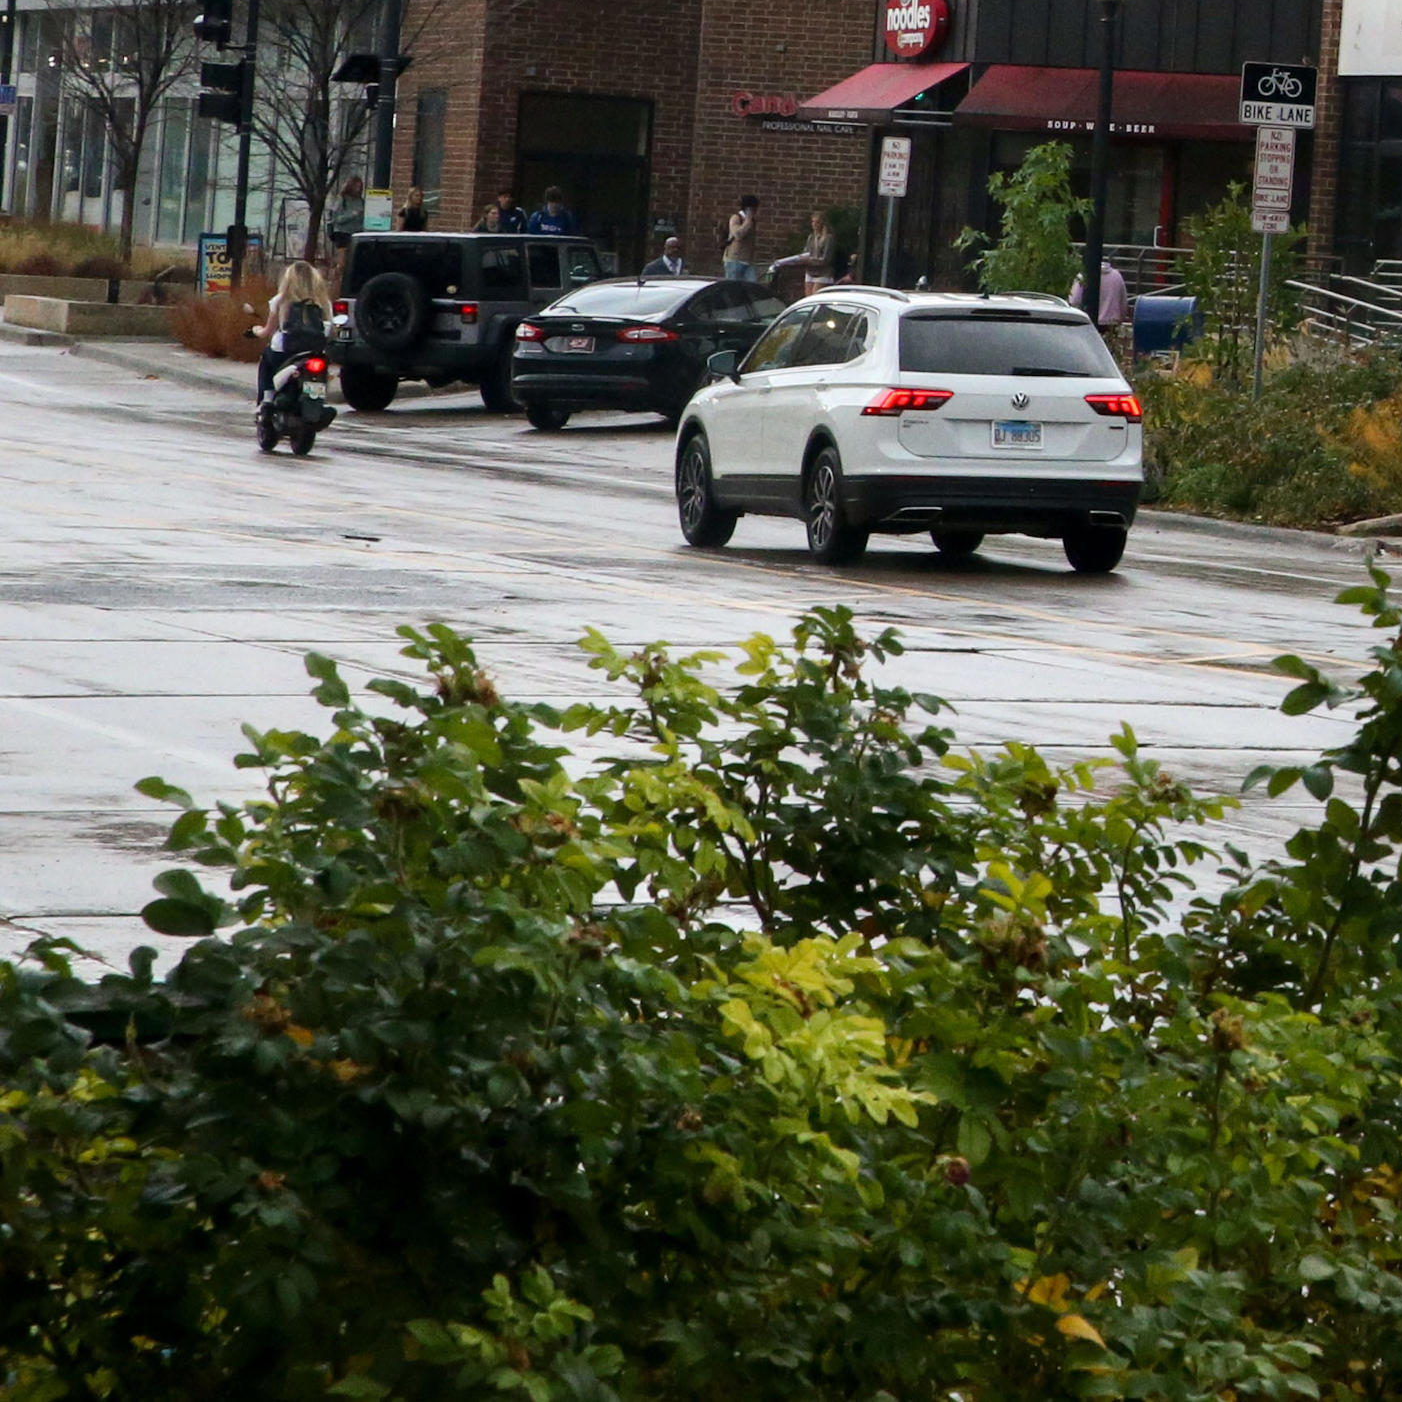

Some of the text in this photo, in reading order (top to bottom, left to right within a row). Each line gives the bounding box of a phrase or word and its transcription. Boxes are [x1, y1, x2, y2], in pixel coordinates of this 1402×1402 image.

[1244, 104, 1312, 123] BIKE LANE
[1047, 120, 1155, 134] SOUP WE BEER
[1260, 142, 1292, 153] PARKING
